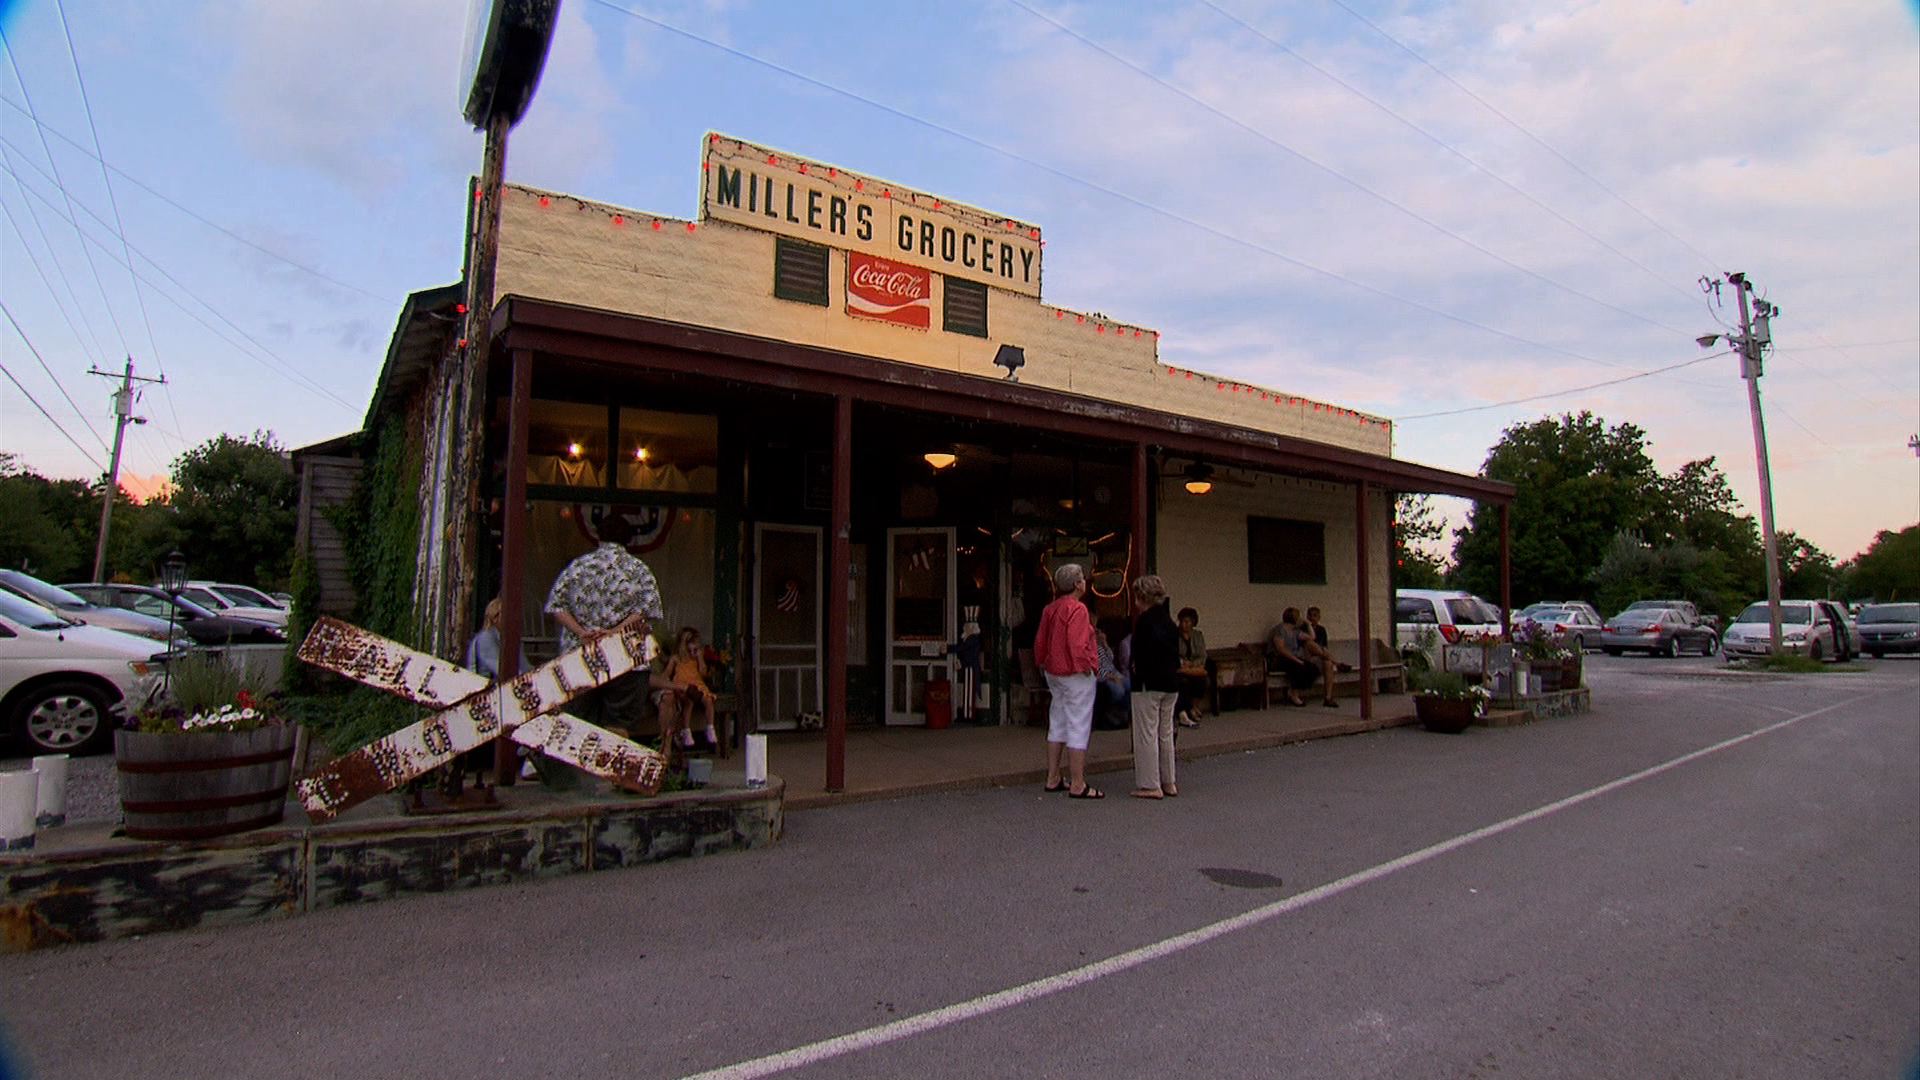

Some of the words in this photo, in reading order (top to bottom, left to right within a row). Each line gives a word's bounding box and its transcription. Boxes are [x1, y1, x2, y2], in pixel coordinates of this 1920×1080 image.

[717, 163, 873, 241] MILLER'S
[898, 214, 1035, 283] GROCERY
[317, 628, 647, 807] CROSSING
